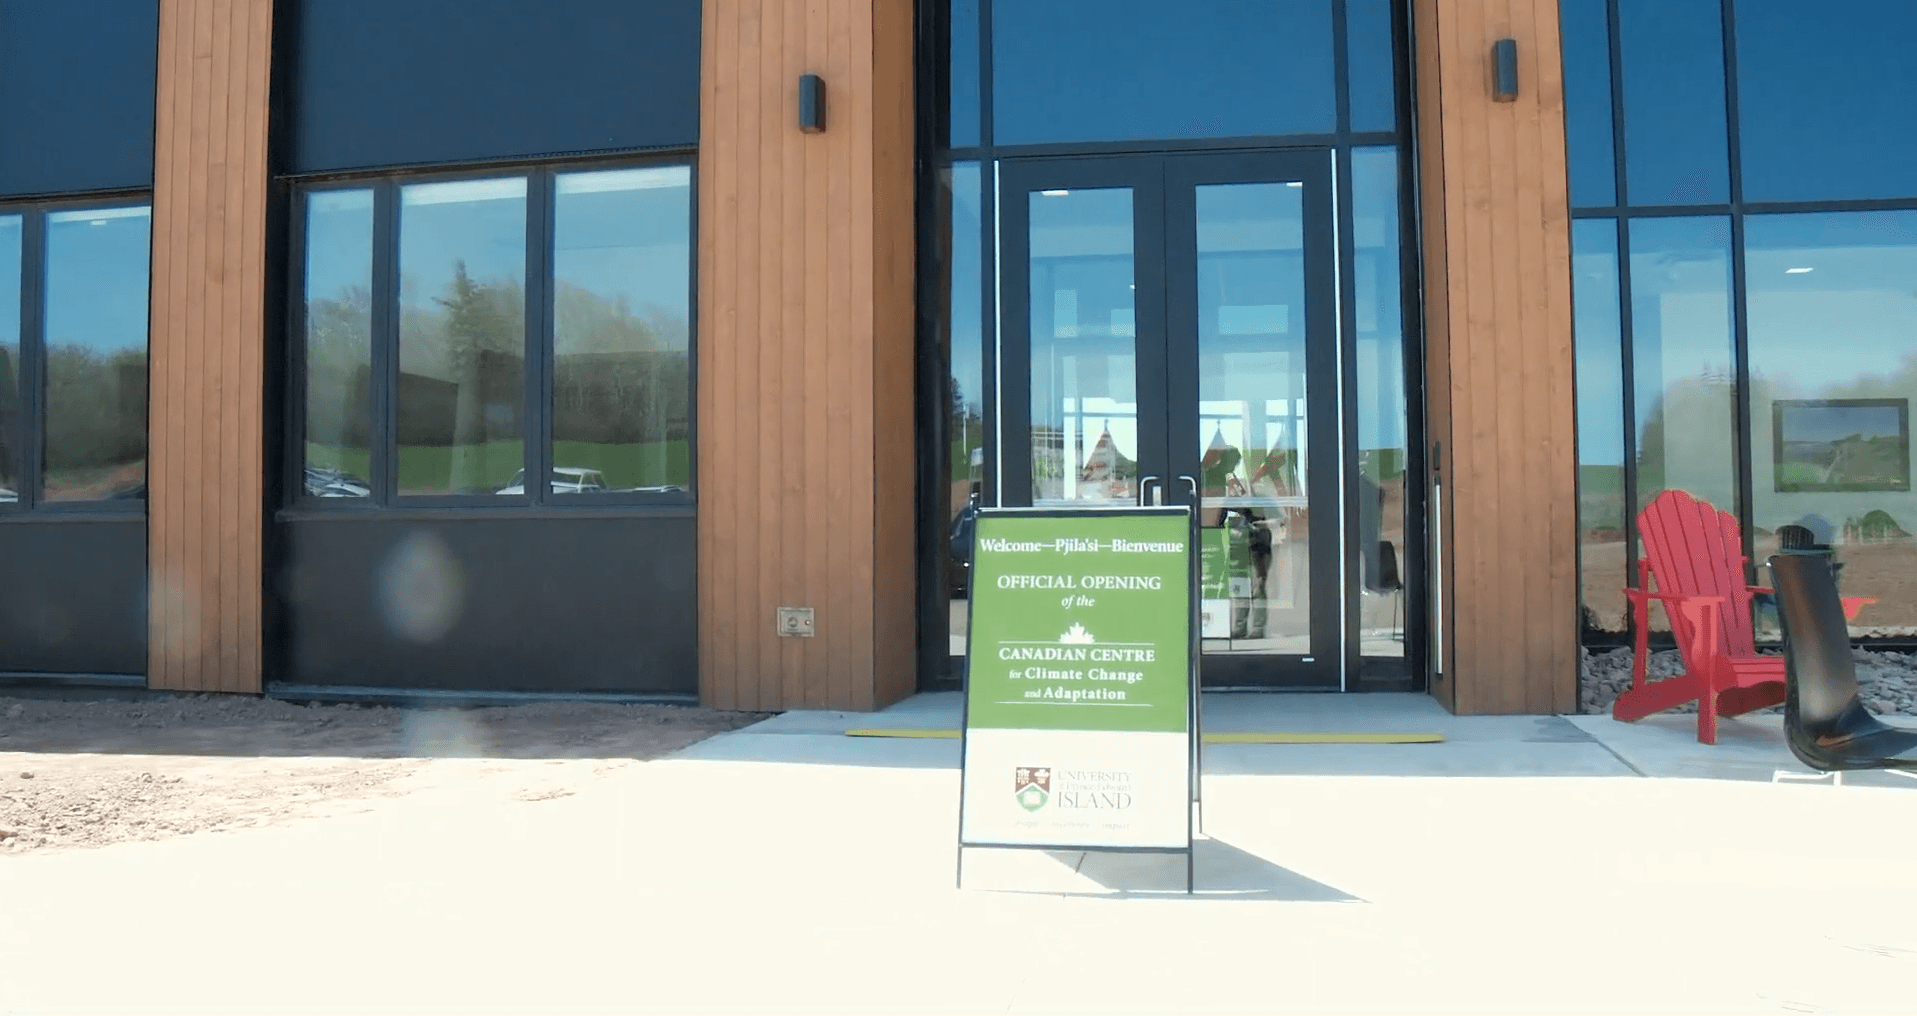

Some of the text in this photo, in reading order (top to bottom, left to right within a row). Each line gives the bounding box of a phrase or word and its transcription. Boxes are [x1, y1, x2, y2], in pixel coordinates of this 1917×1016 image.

[997, 575, 1162, 590] OFFICIAL OPENING
[1061, 595, 1095, 609] of the
[998, 647, 1156, 662] CANADIAN CENTRE
[1009, 667, 1144, 684] for Climate Change
[1024, 687, 1126, 702] and Adaptation
[1058, 770, 1132, 782] UNIVERSITY
[1058, 791, 1132, 810] ISLAND
